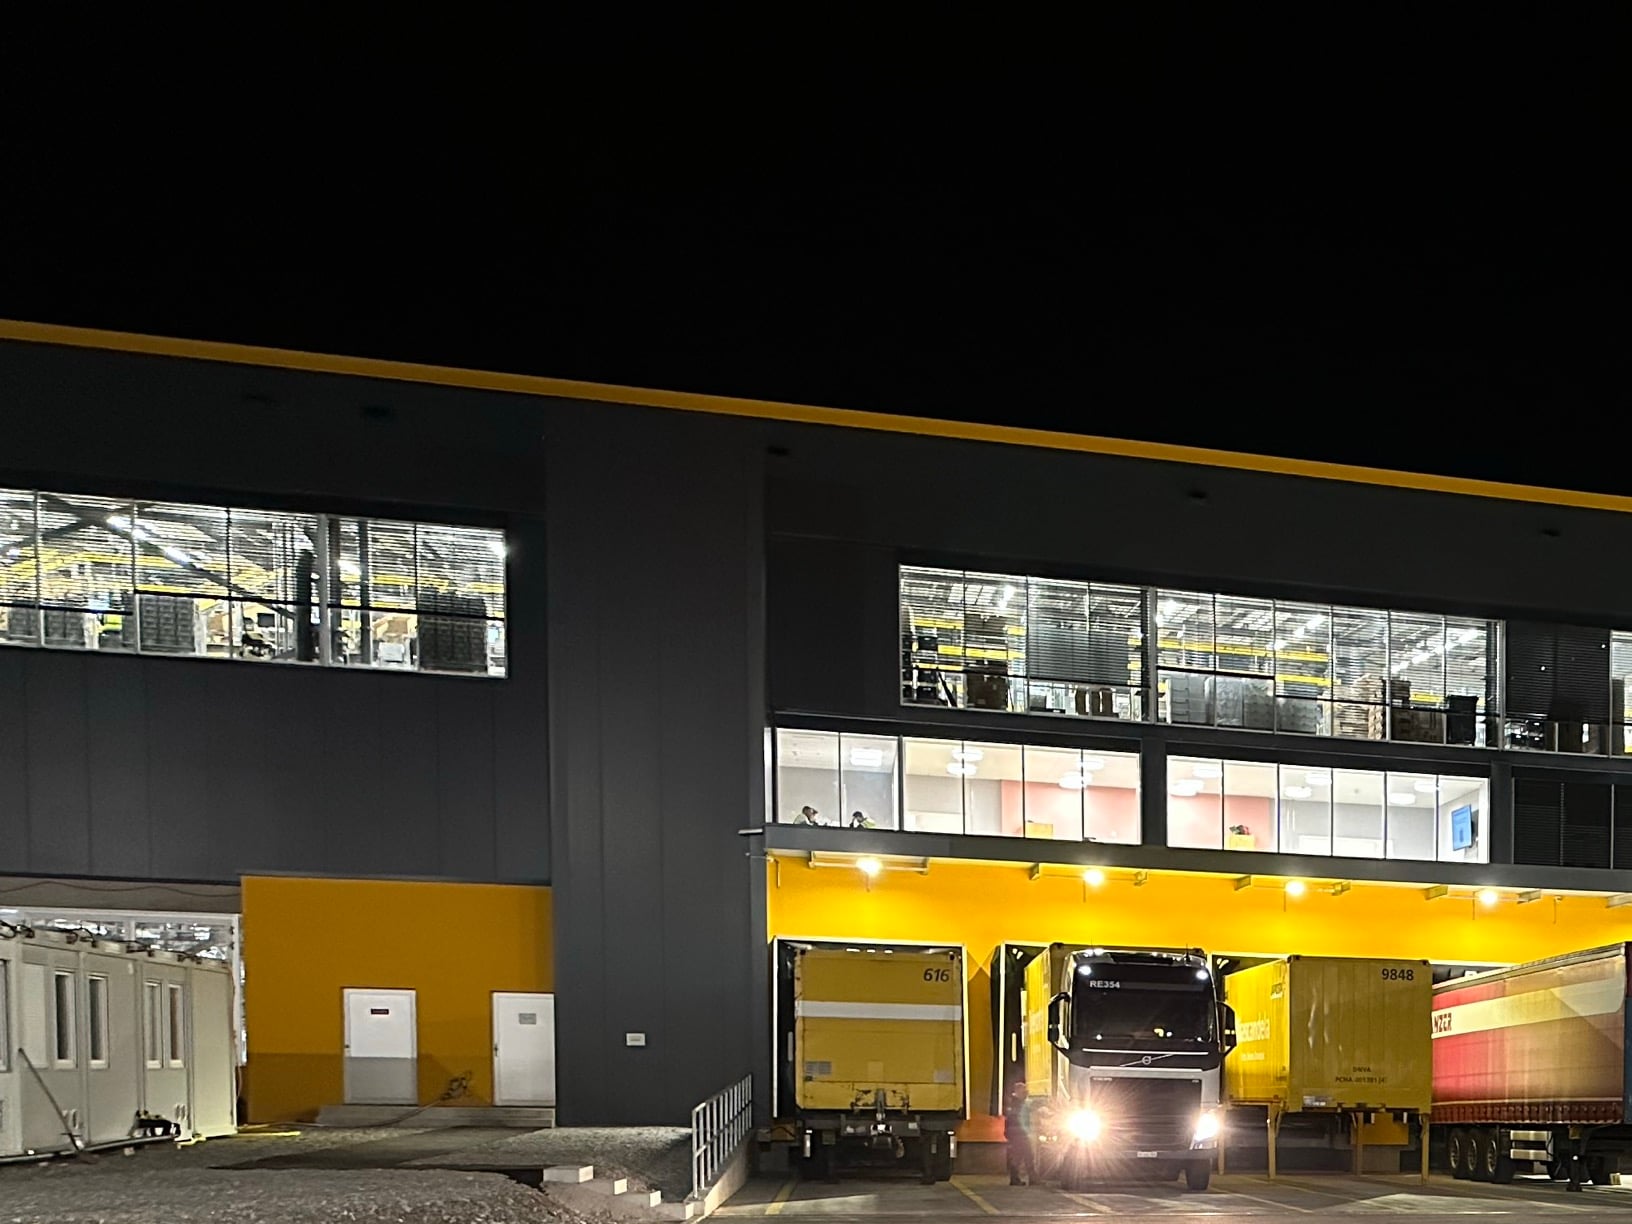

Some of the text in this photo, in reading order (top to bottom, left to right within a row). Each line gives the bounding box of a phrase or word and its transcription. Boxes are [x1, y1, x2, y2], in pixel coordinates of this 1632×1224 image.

[923, 968, 950, 982] 616
[1382, 968, 1414, 981] 9848
[1089, 980, 1121, 989] RE354
